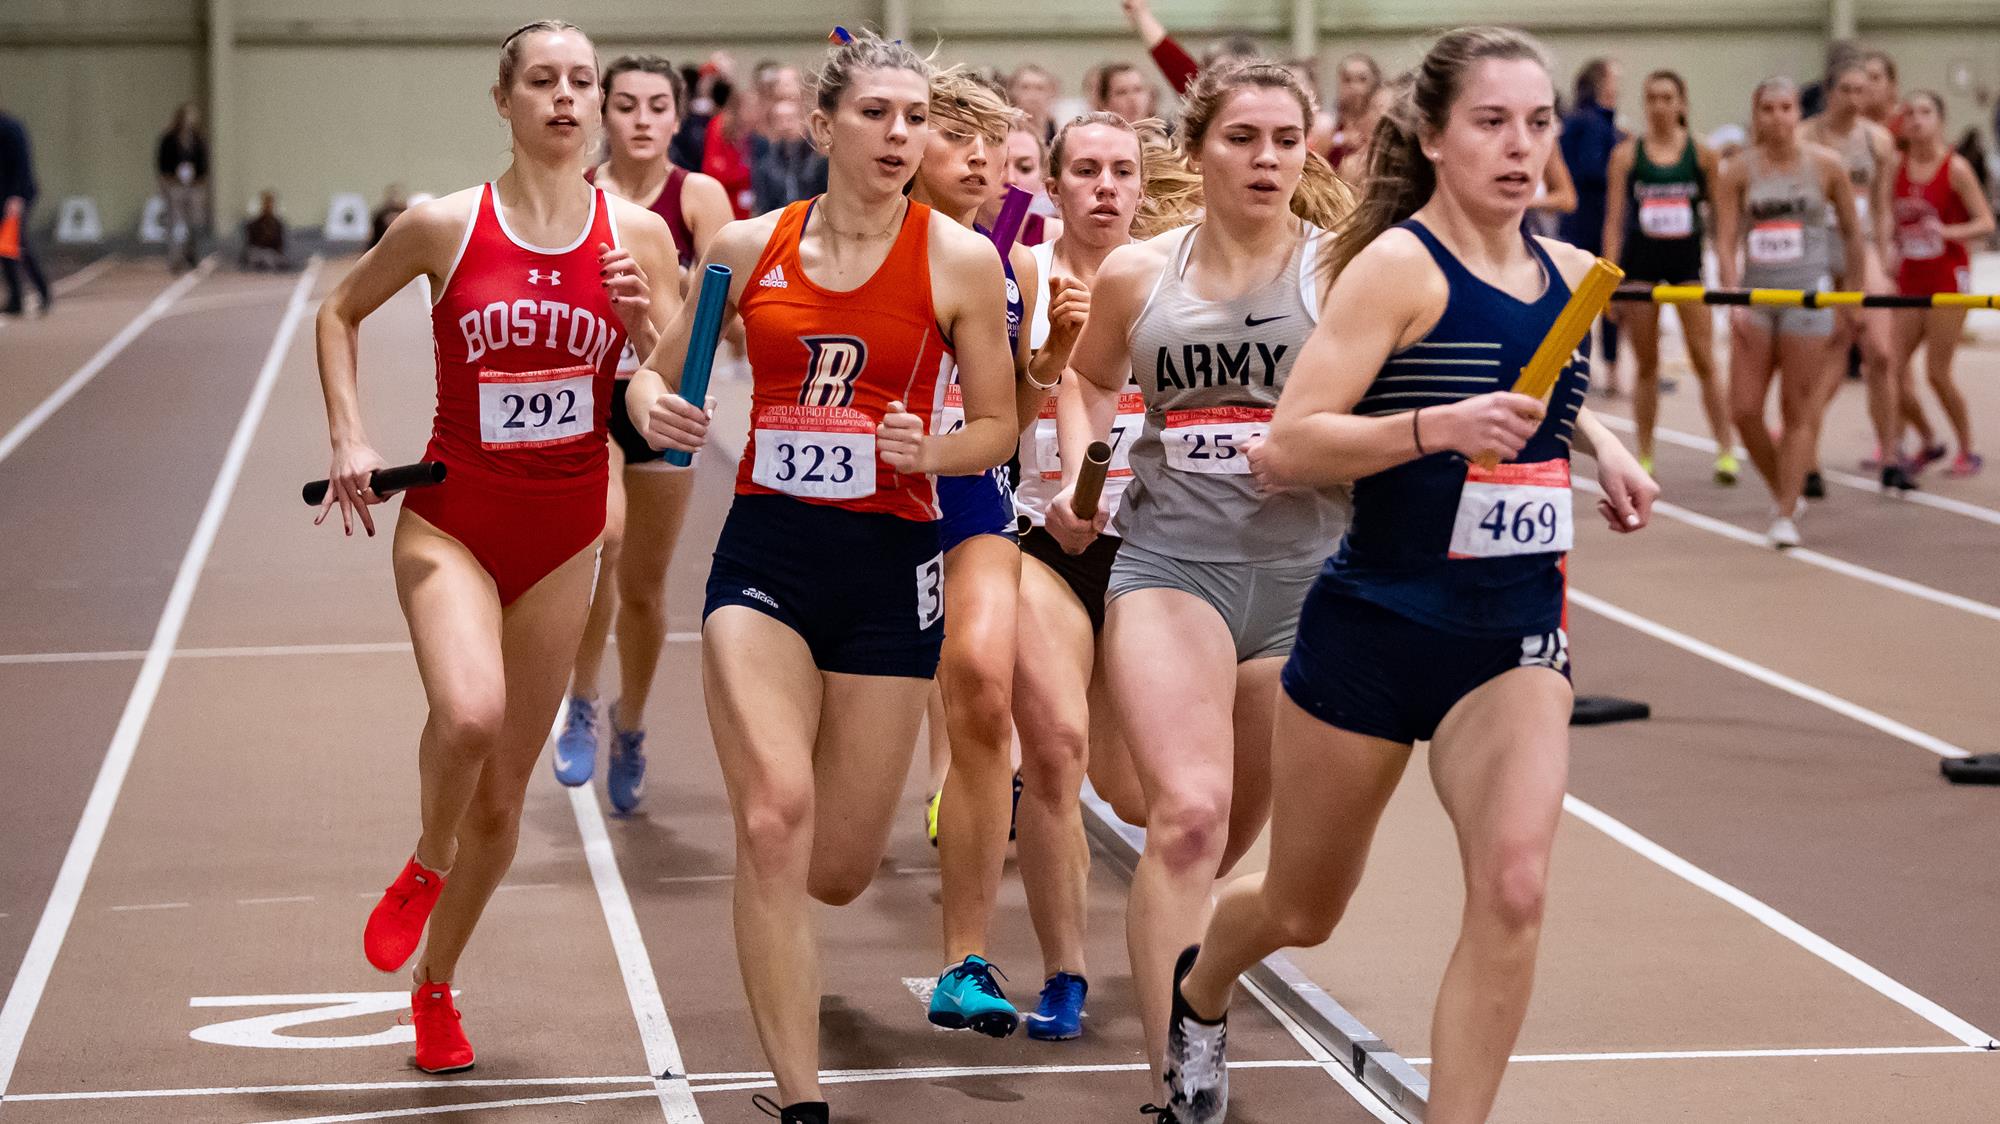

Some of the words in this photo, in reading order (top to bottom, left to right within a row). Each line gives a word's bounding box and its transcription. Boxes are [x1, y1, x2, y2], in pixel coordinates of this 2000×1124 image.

[759, 279, 788, 289] adidas
[459, 299, 617, 374] BOSTON
[1156, 342, 1288, 392] ARMY
[502, 389, 577, 429] 292
[789, 406, 828, 417] PATRIOT
[776, 443, 854, 483] 323
[1183, 432, 1261, 460] 25
[1479, 500, 1557, 545] 469
[742, 589, 779, 609] adidas
